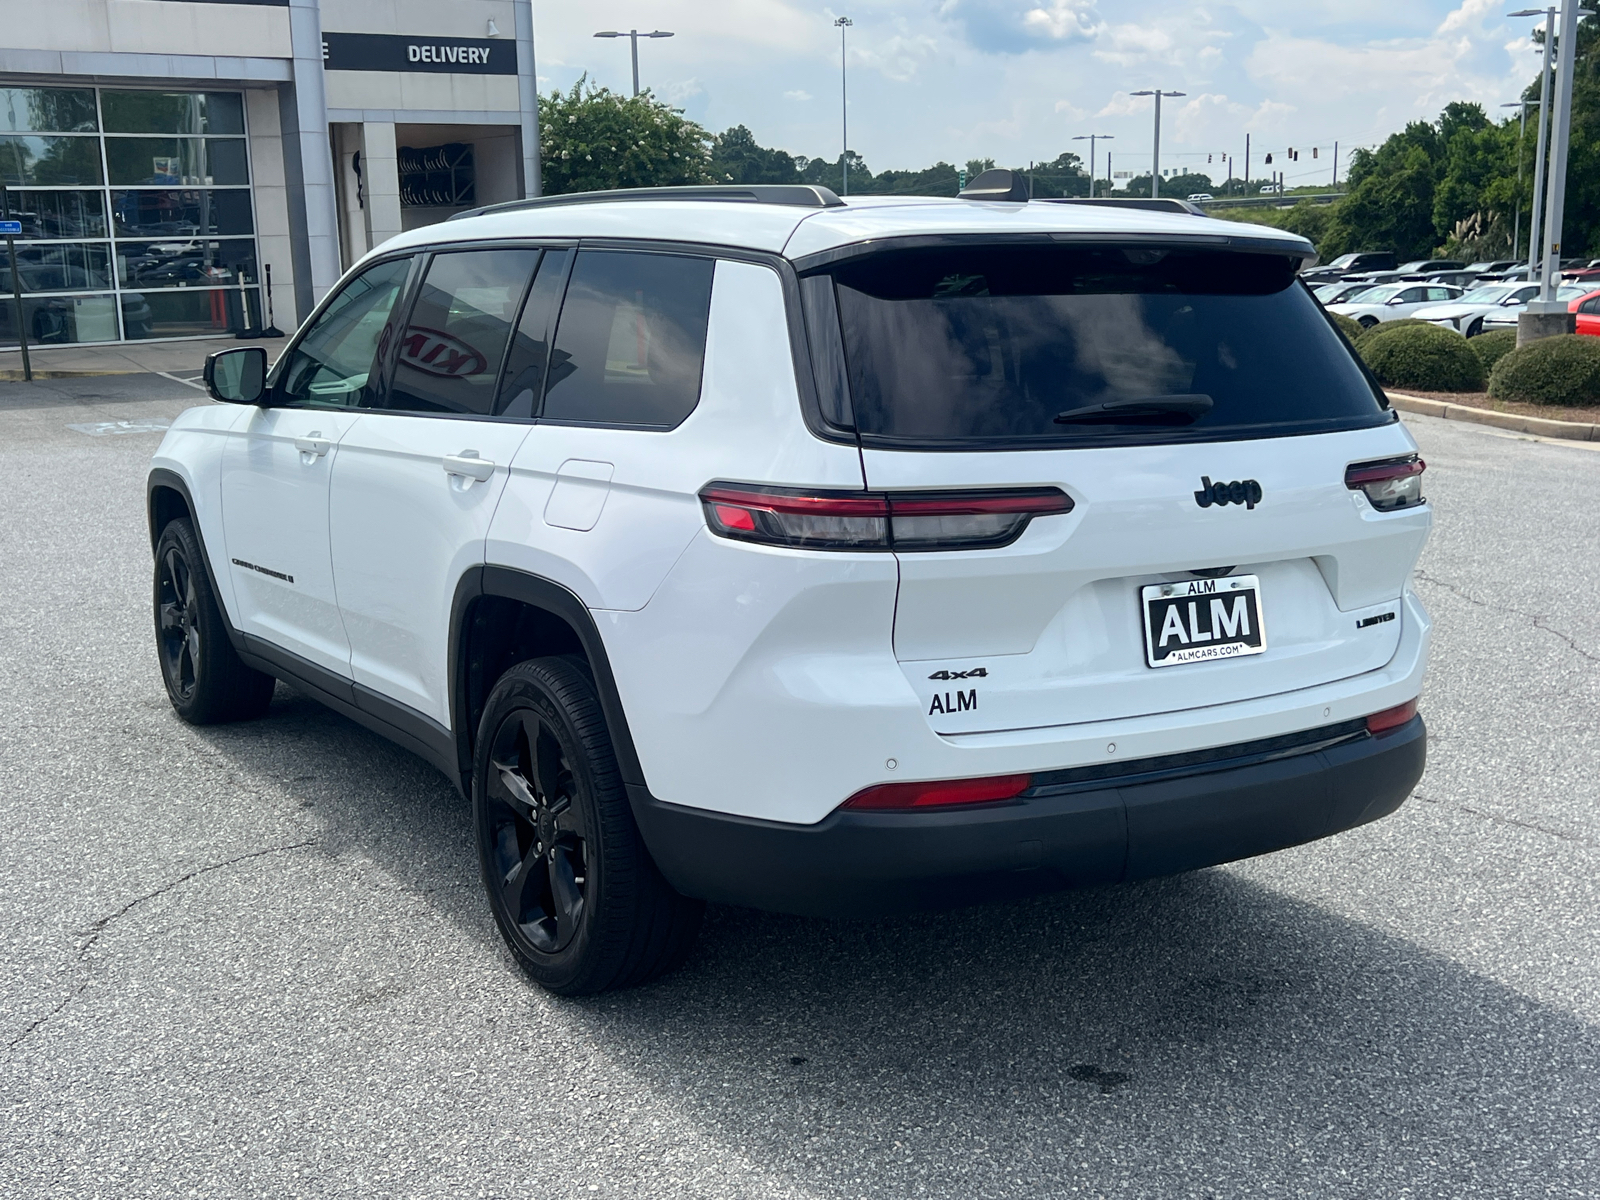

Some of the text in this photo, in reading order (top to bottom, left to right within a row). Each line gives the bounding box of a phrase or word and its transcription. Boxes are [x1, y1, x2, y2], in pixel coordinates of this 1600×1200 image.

[408, 45, 490, 64] DELIVERY
[1194, 476, 1262, 510] Jeep
[1187, 580, 1216, 595] ALM
[1158, 595, 1251, 648] ALM
[1177, 645, 1239, 661] ALMCARS.COM
[928, 667, 989, 680] 4x4
[928, 689, 977, 716] ALM
